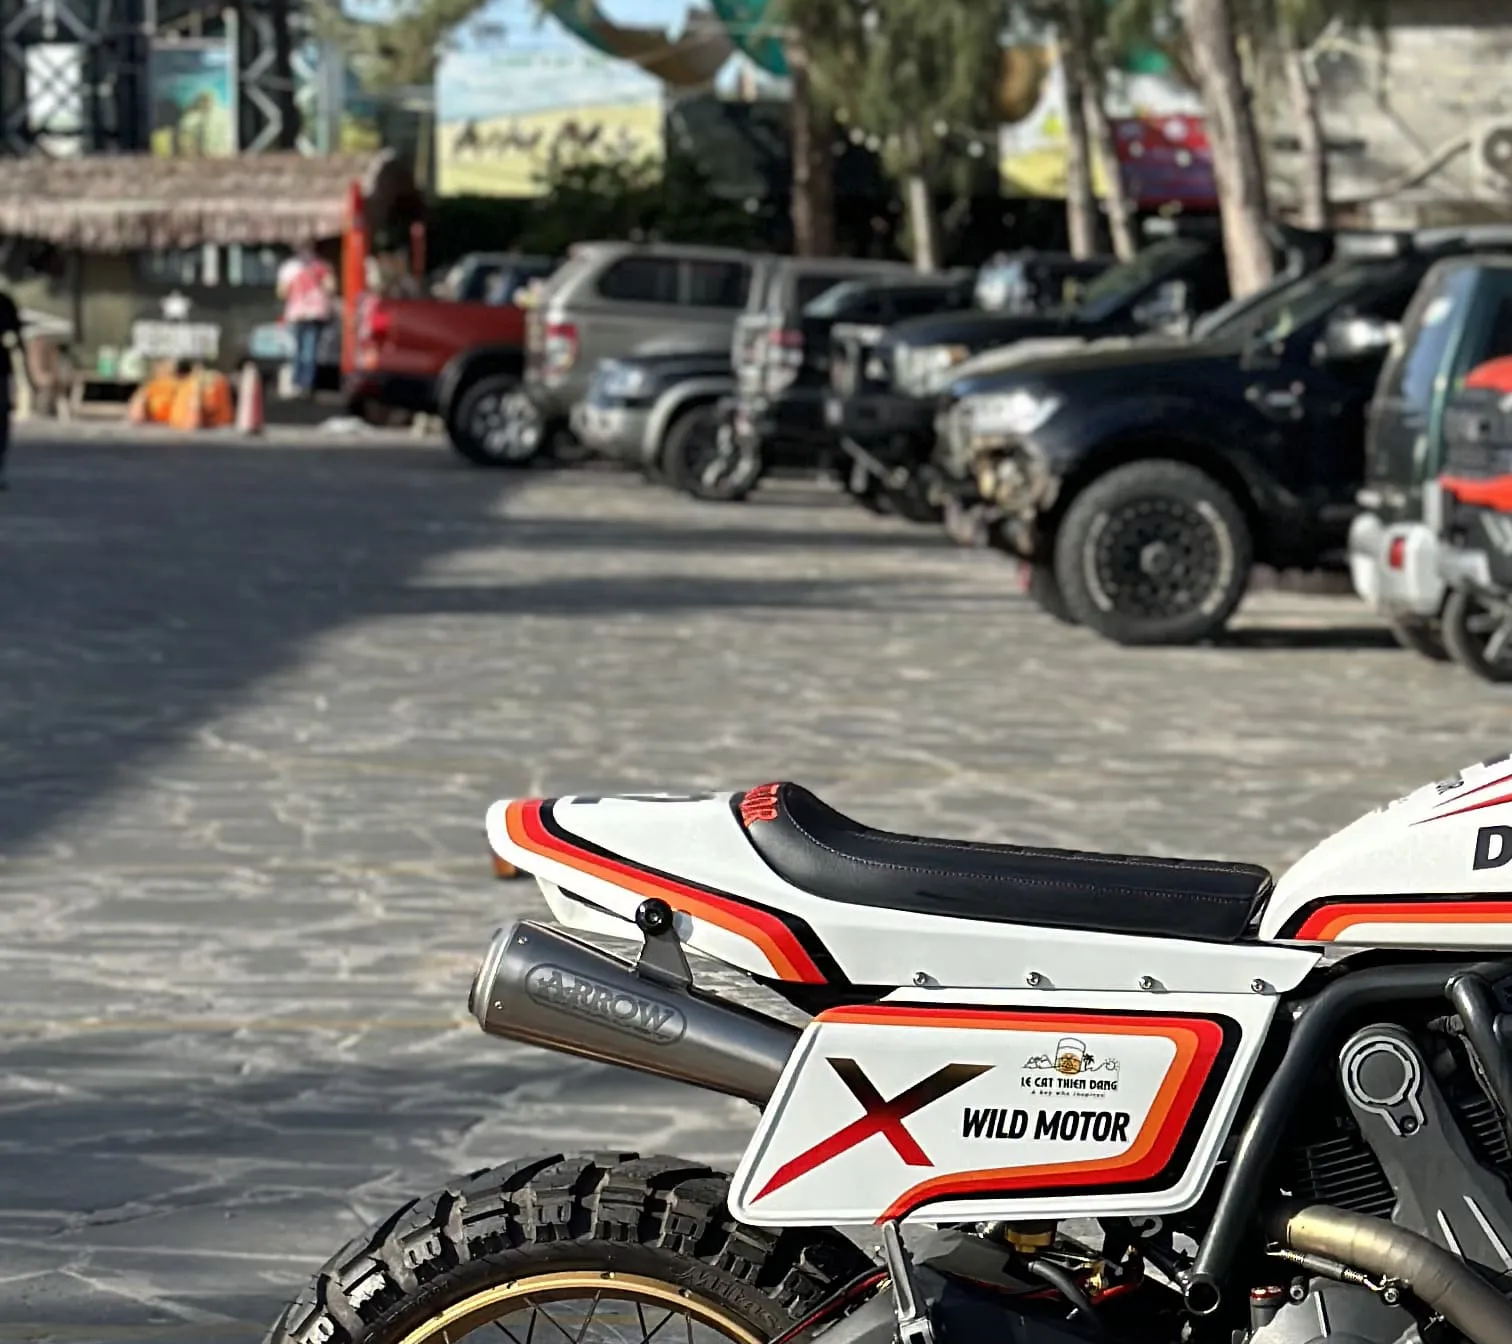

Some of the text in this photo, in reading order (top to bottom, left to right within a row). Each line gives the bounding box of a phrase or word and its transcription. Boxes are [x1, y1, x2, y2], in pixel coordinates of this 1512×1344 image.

[536, 970, 677, 1040] ARROW
[1021, 1077, 1119, 1091] LE CAT THIEN DANG
[962, 1107, 1131, 1142] WILD MOTOR
